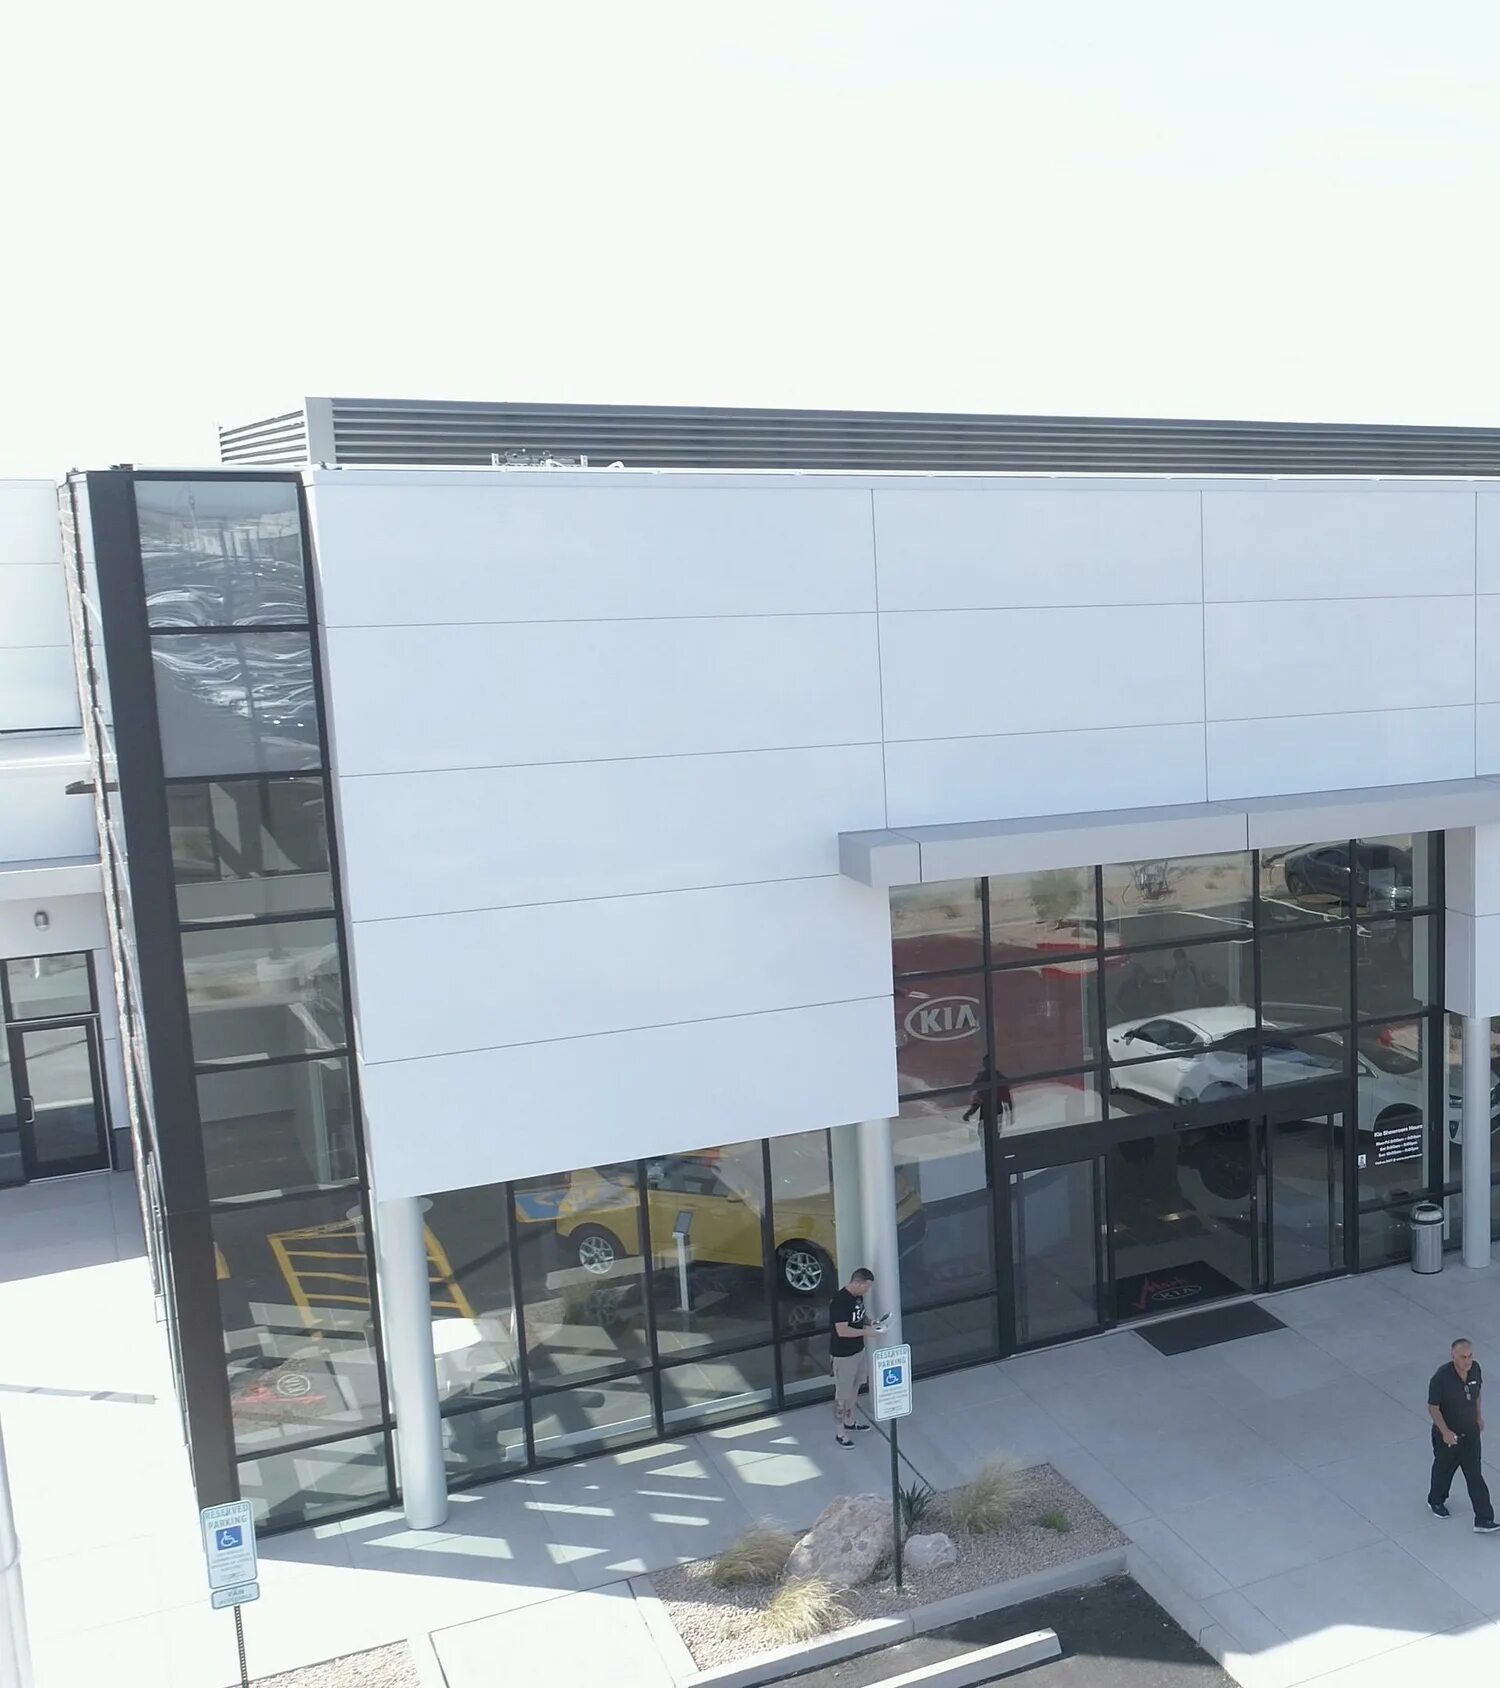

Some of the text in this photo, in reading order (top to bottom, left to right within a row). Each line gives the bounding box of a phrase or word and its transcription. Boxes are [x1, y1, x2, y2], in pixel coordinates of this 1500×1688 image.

[919, 1004, 978, 1034] KIA
[877, 1348, 907, 1359] RESERVED
[878, 1355, 906, 1368] PARKING
[205, 1504, 248, 1519] RESERVED
[207, 1514, 247, 1529] PARKING
